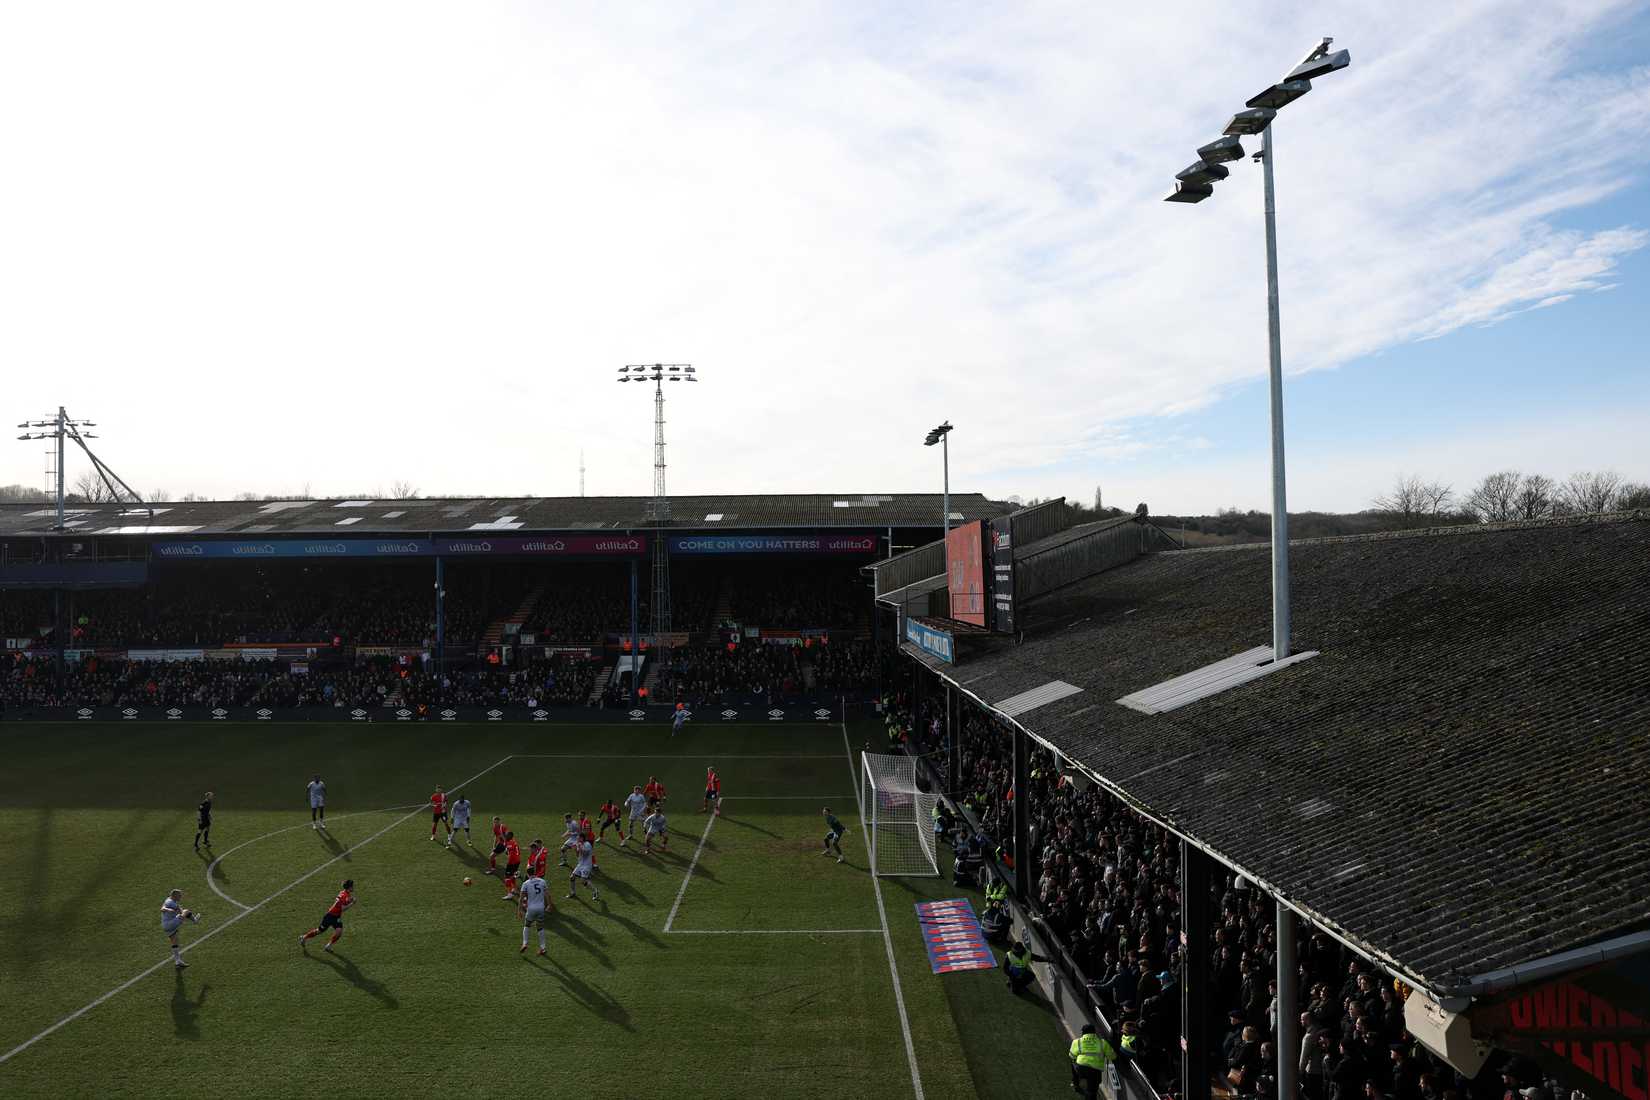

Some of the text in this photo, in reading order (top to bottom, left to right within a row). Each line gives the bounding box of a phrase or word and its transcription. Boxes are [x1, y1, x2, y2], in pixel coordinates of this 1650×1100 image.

[449, 543, 481, 552] utilita
[522, 542, 553, 551] utilita
[595, 541, 628, 551] utilita
[678, 540, 820, 550] COME ON YOU HATTERS!
[829, 540, 861, 549] utilita
[534, 883, 541, 894] 5
